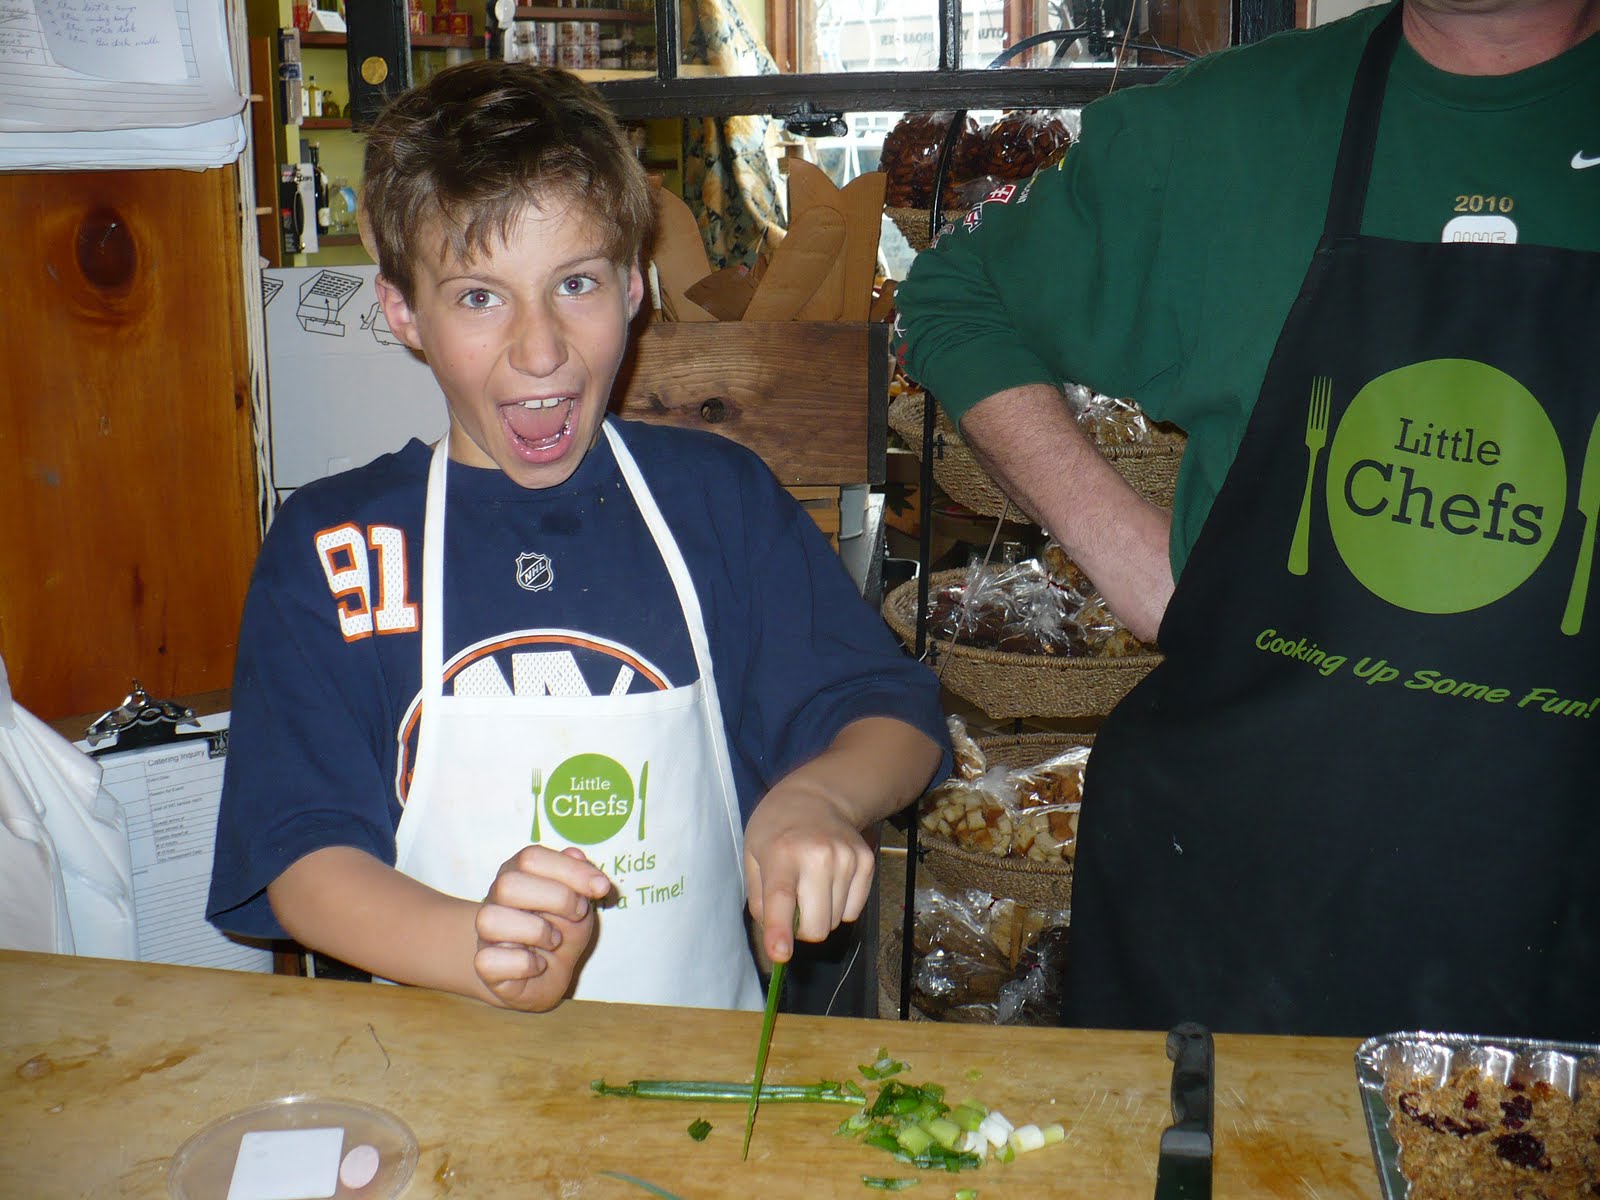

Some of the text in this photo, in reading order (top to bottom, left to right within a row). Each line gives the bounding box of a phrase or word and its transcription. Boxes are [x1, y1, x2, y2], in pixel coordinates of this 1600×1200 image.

[1454, 194, 1514, 213] 2010
[1394, 417, 1501, 466] Little
[1344, 459, 1544, 546] Chefs
[314, 522, 420, 643] 91
[524, 562, 545, 583] NHL
[1255, 628, 1600, 719] Cooking Up Some Fun!
[147, 755, 179, 767] Catering
[180, 750, 205, 760] Inquiry
[570, 777, 611, 791] Little
[552, 795, 628, 817] Chefs
[614, 851, 656, 875] Kids
[617, 875, 684, 909] a Time!
